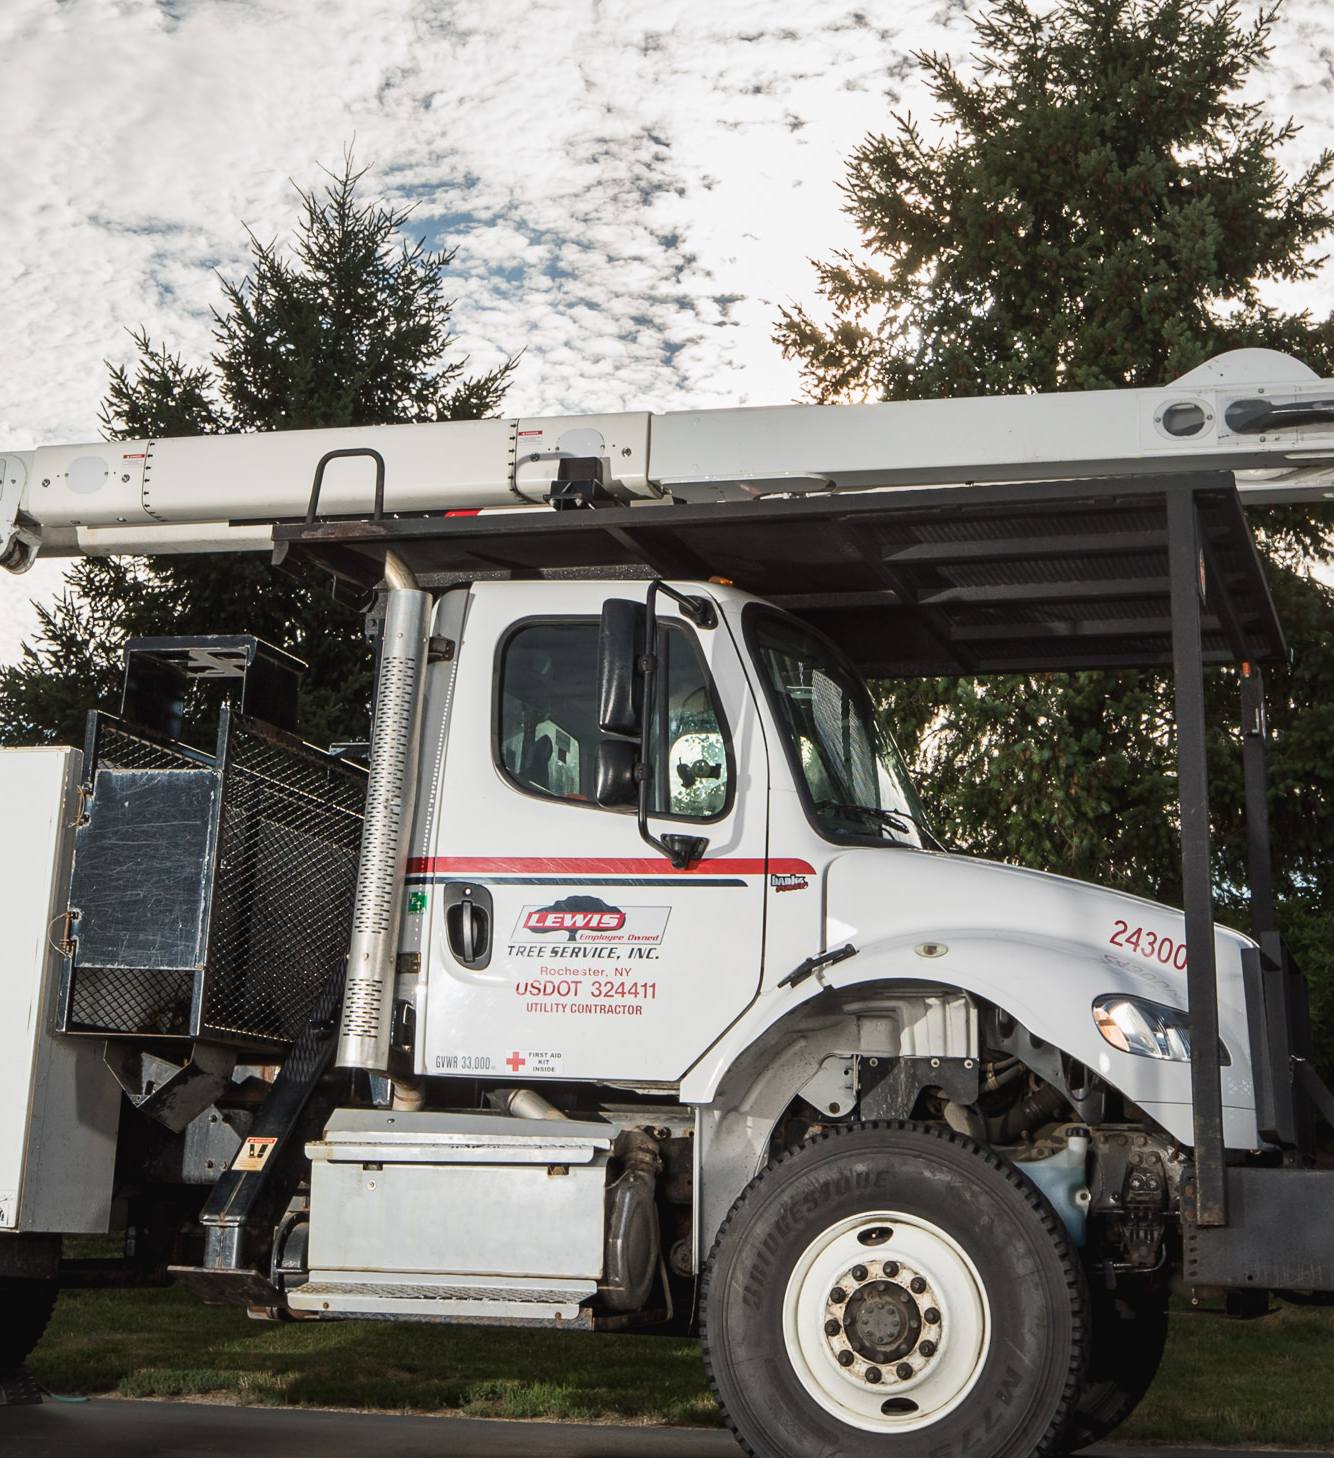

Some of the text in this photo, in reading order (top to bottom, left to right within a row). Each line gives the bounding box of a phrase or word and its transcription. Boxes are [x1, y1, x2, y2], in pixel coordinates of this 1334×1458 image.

[527, 914, 621, 928] LEWIS
[579, 933, 624, 942] Employee
[1109, 920, 1187, 970] 24300
[508, 945, 659, 960] TREE SERVICE, INC.
[540, 966, 632, 977] Rochester, NY
[516, 980, 656, 999] USDOT 324411
[526, 1002, 642, 1015] UTILITY CONTRACTOR
[436, 1055, 458, 1069] GVWR
